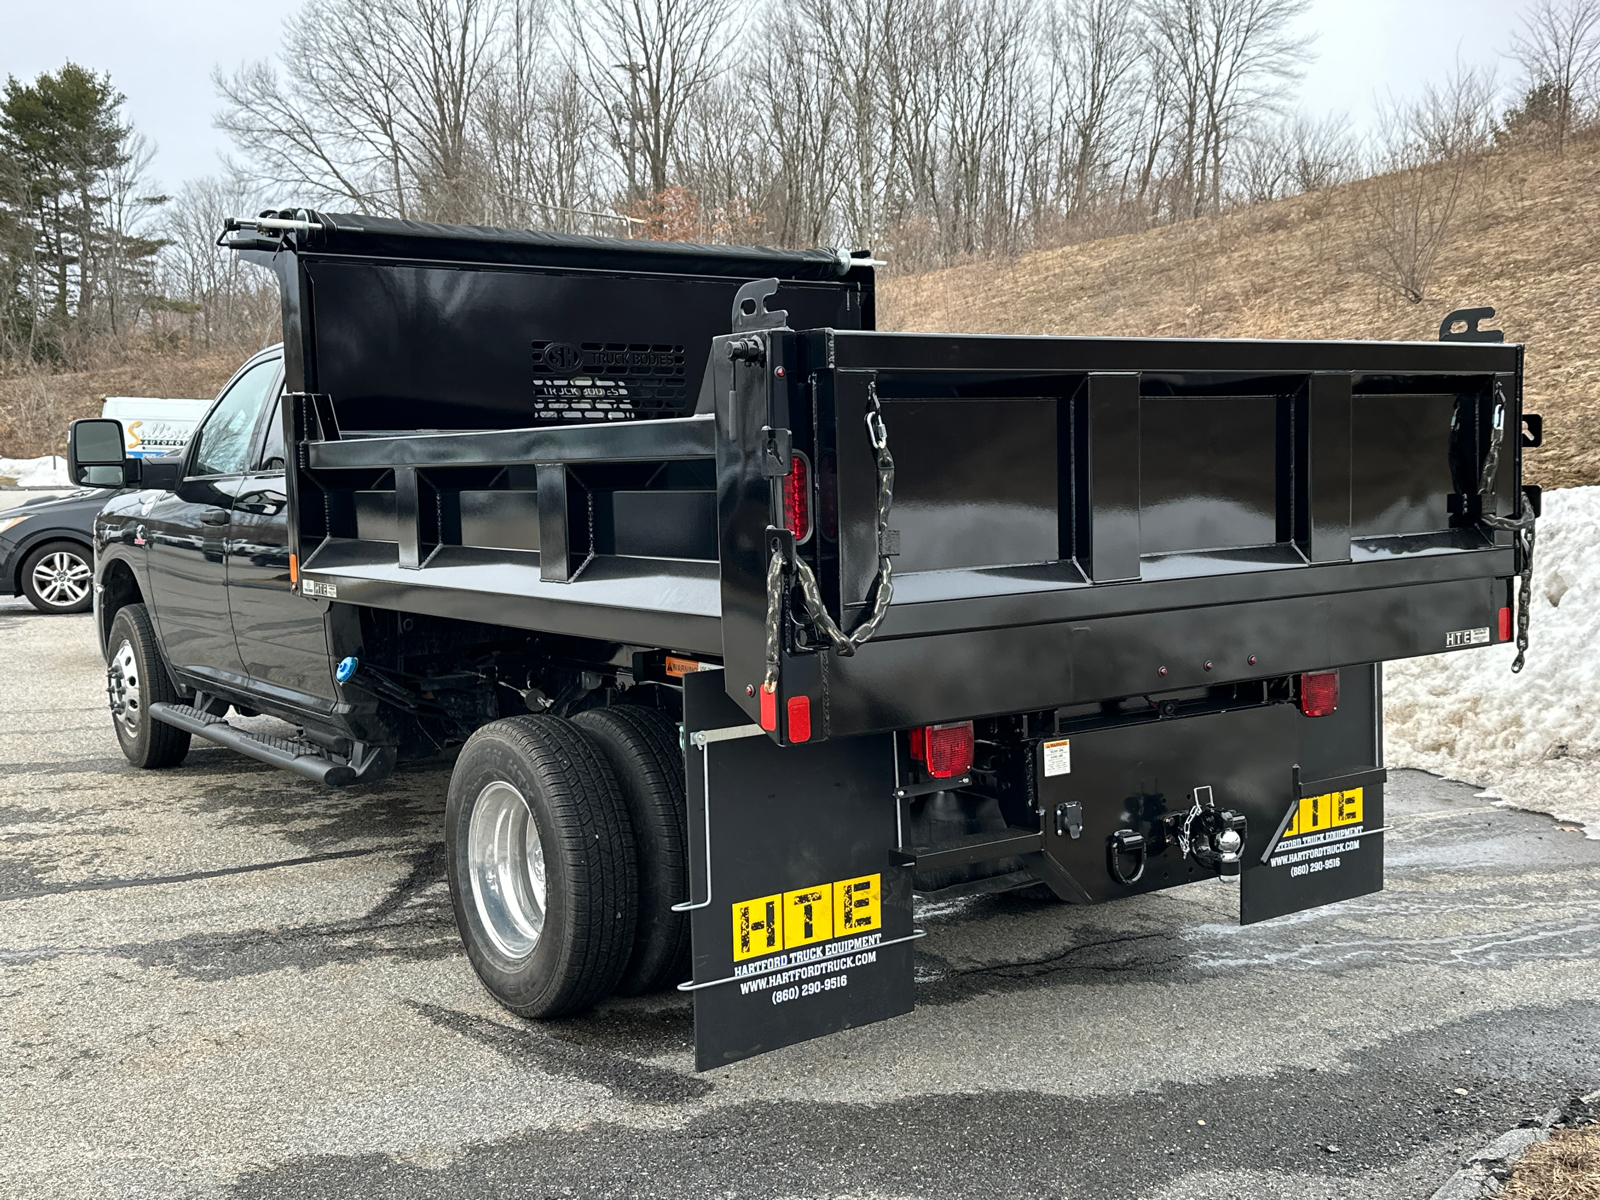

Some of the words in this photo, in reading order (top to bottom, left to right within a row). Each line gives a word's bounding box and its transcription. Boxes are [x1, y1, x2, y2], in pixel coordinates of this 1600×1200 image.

[591, 353, 630, 365] TRUCK
[633, 353, 674, 366] BODIES
[1446, 631, 1471, 646] HTE
[1270, 840, 1360, 867] WWW.HARTFORDTRUCK.COM
[1290, 863, 1309, 878] (860)
[1309, 857, 1341, 873] 290-9516
[738, 880, 873, 954] HTE
[734, 955, 788, 977] HARTFORD
[789, 947, 823, 966] TRUCK
[825, 933, 882, 956] EQUIPMENT
[740, 951, 877, 995] WWW.HARTFORDTRUCK.COM
[771, 985, 800, 1005] (860)
[801, 975, 848, 997] 290-9516
